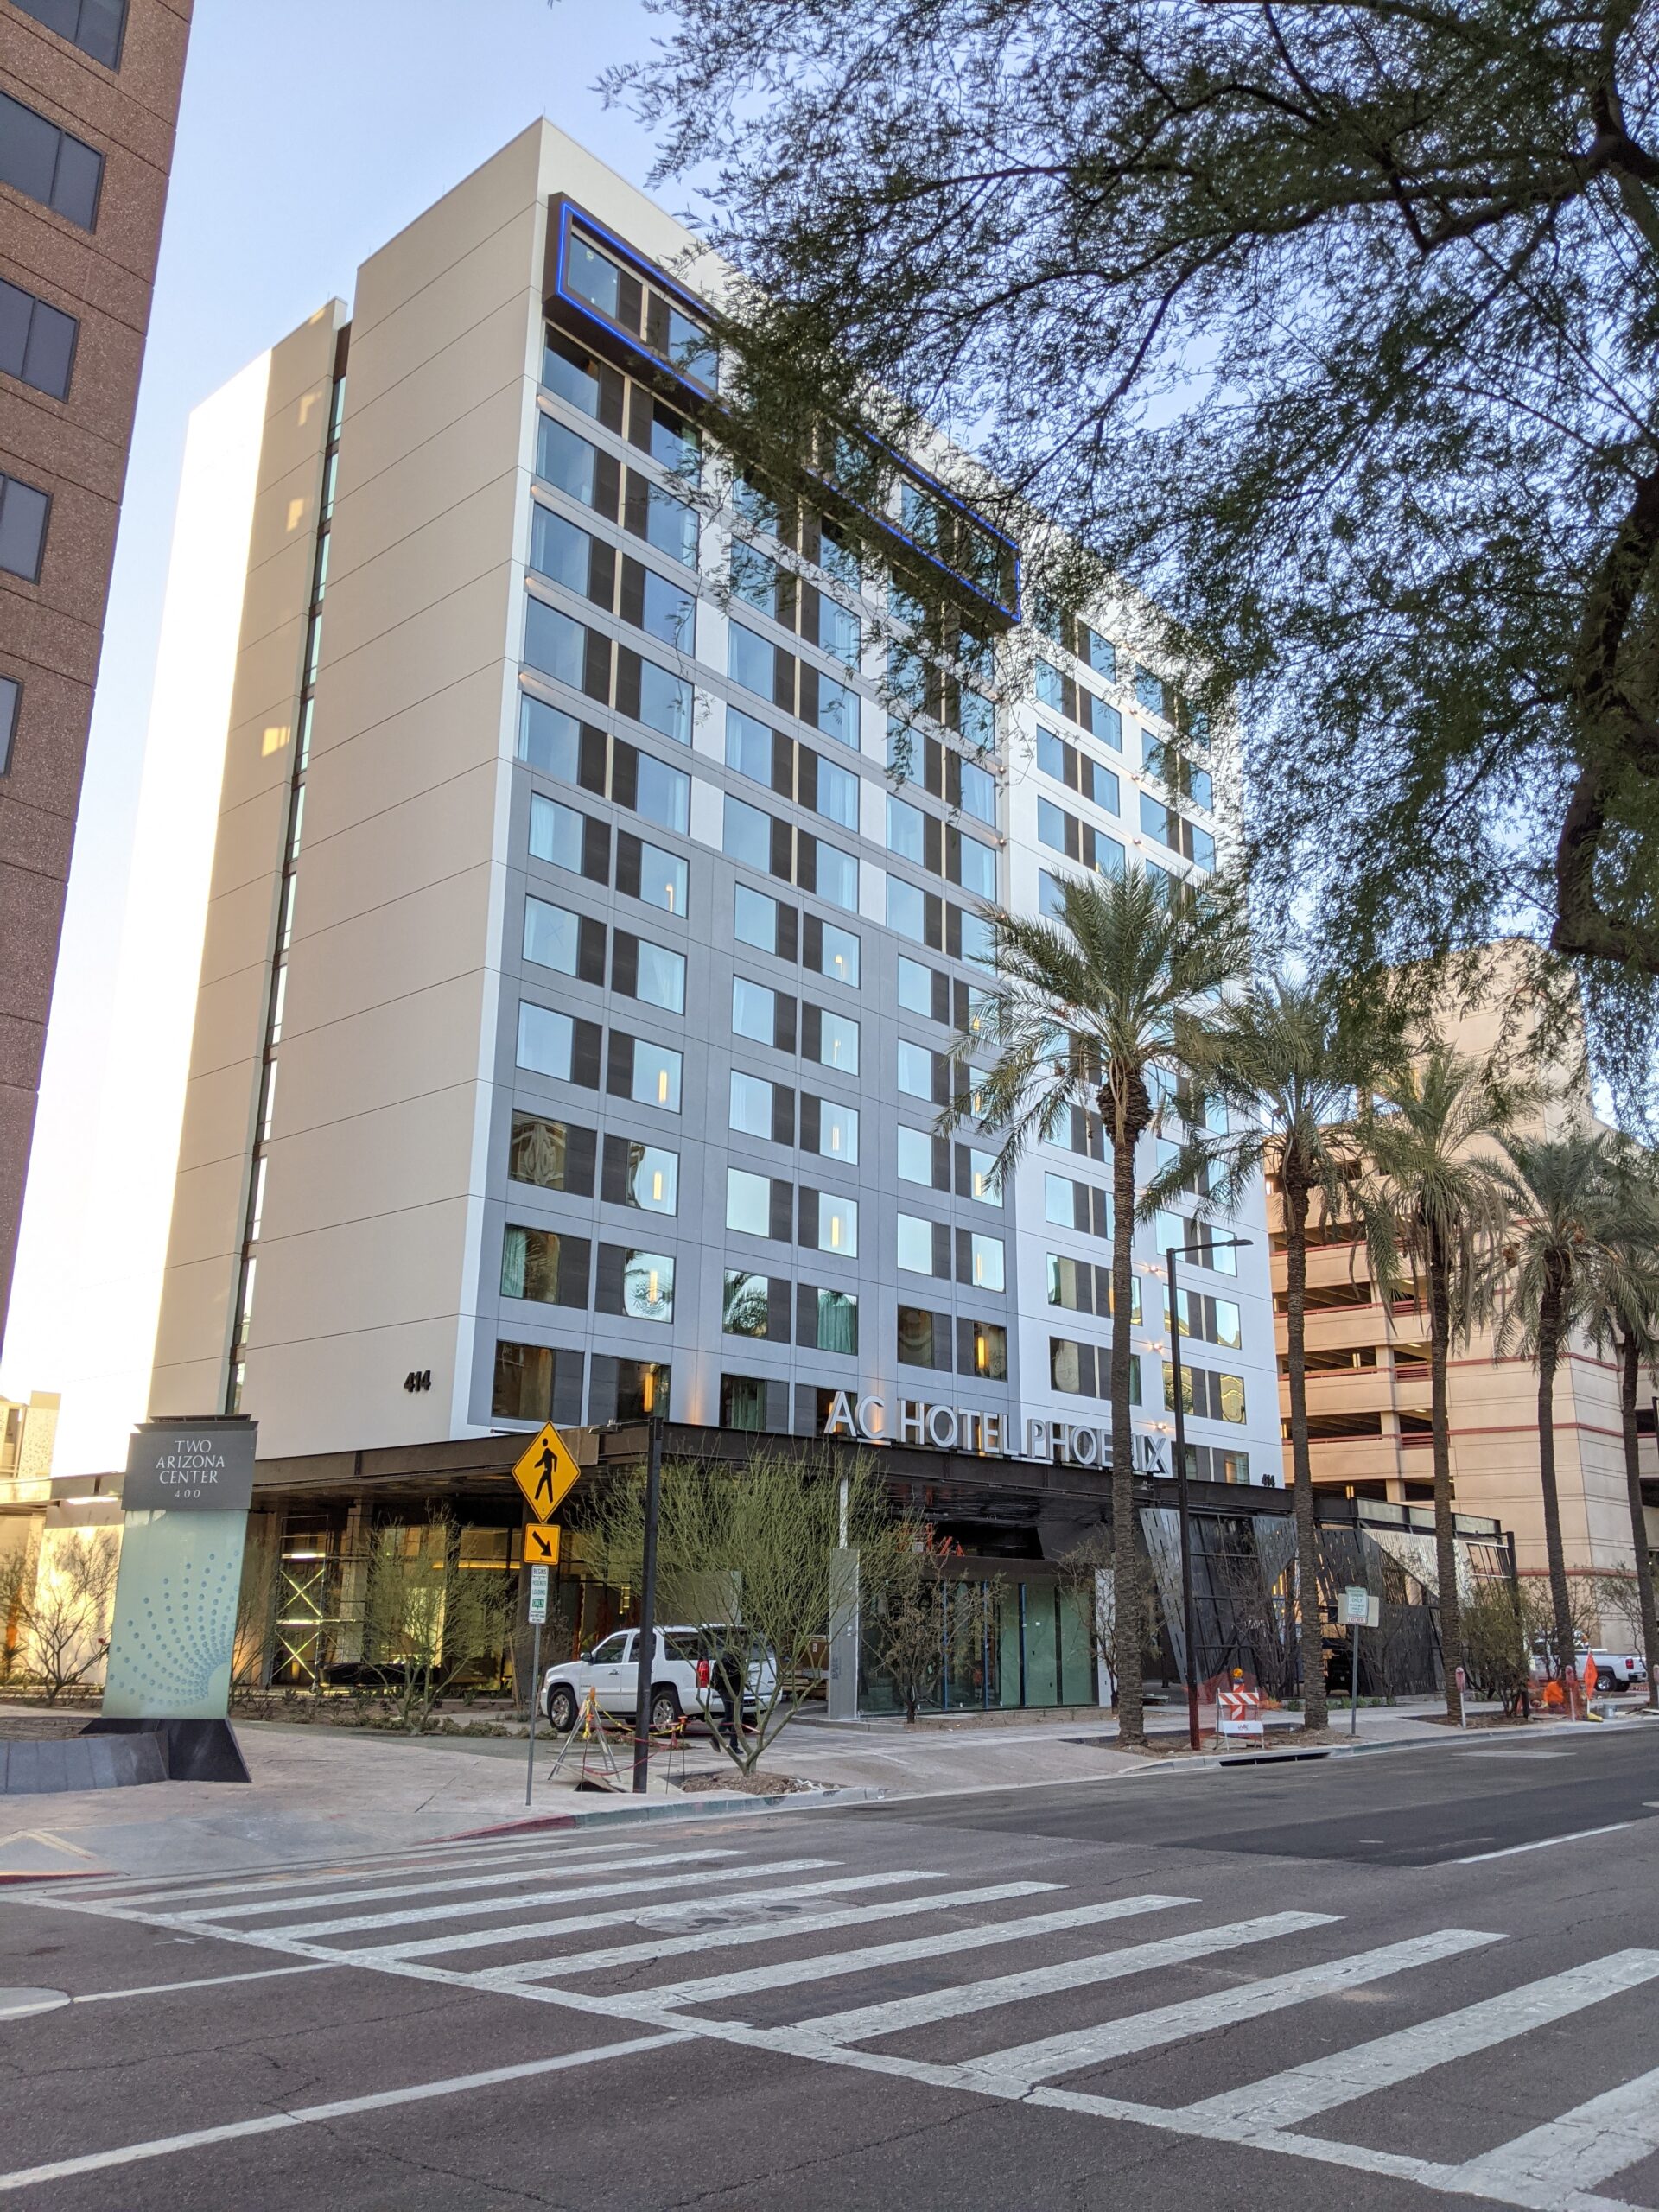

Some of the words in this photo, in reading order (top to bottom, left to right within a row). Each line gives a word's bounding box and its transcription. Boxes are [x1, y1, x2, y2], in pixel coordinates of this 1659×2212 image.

[404, 1370, 431, 1392] 414
[823, 1390, 885, 1440] AC
[896, 1397, 1019, 1456] HOTEL
[175, 1440, 212, 1453] TWO
[156, 1454, 225, 1469] ARIZONA
[159, 1470, 218, 1484] CENTER
[175, 1489, 200, 1498] 400
